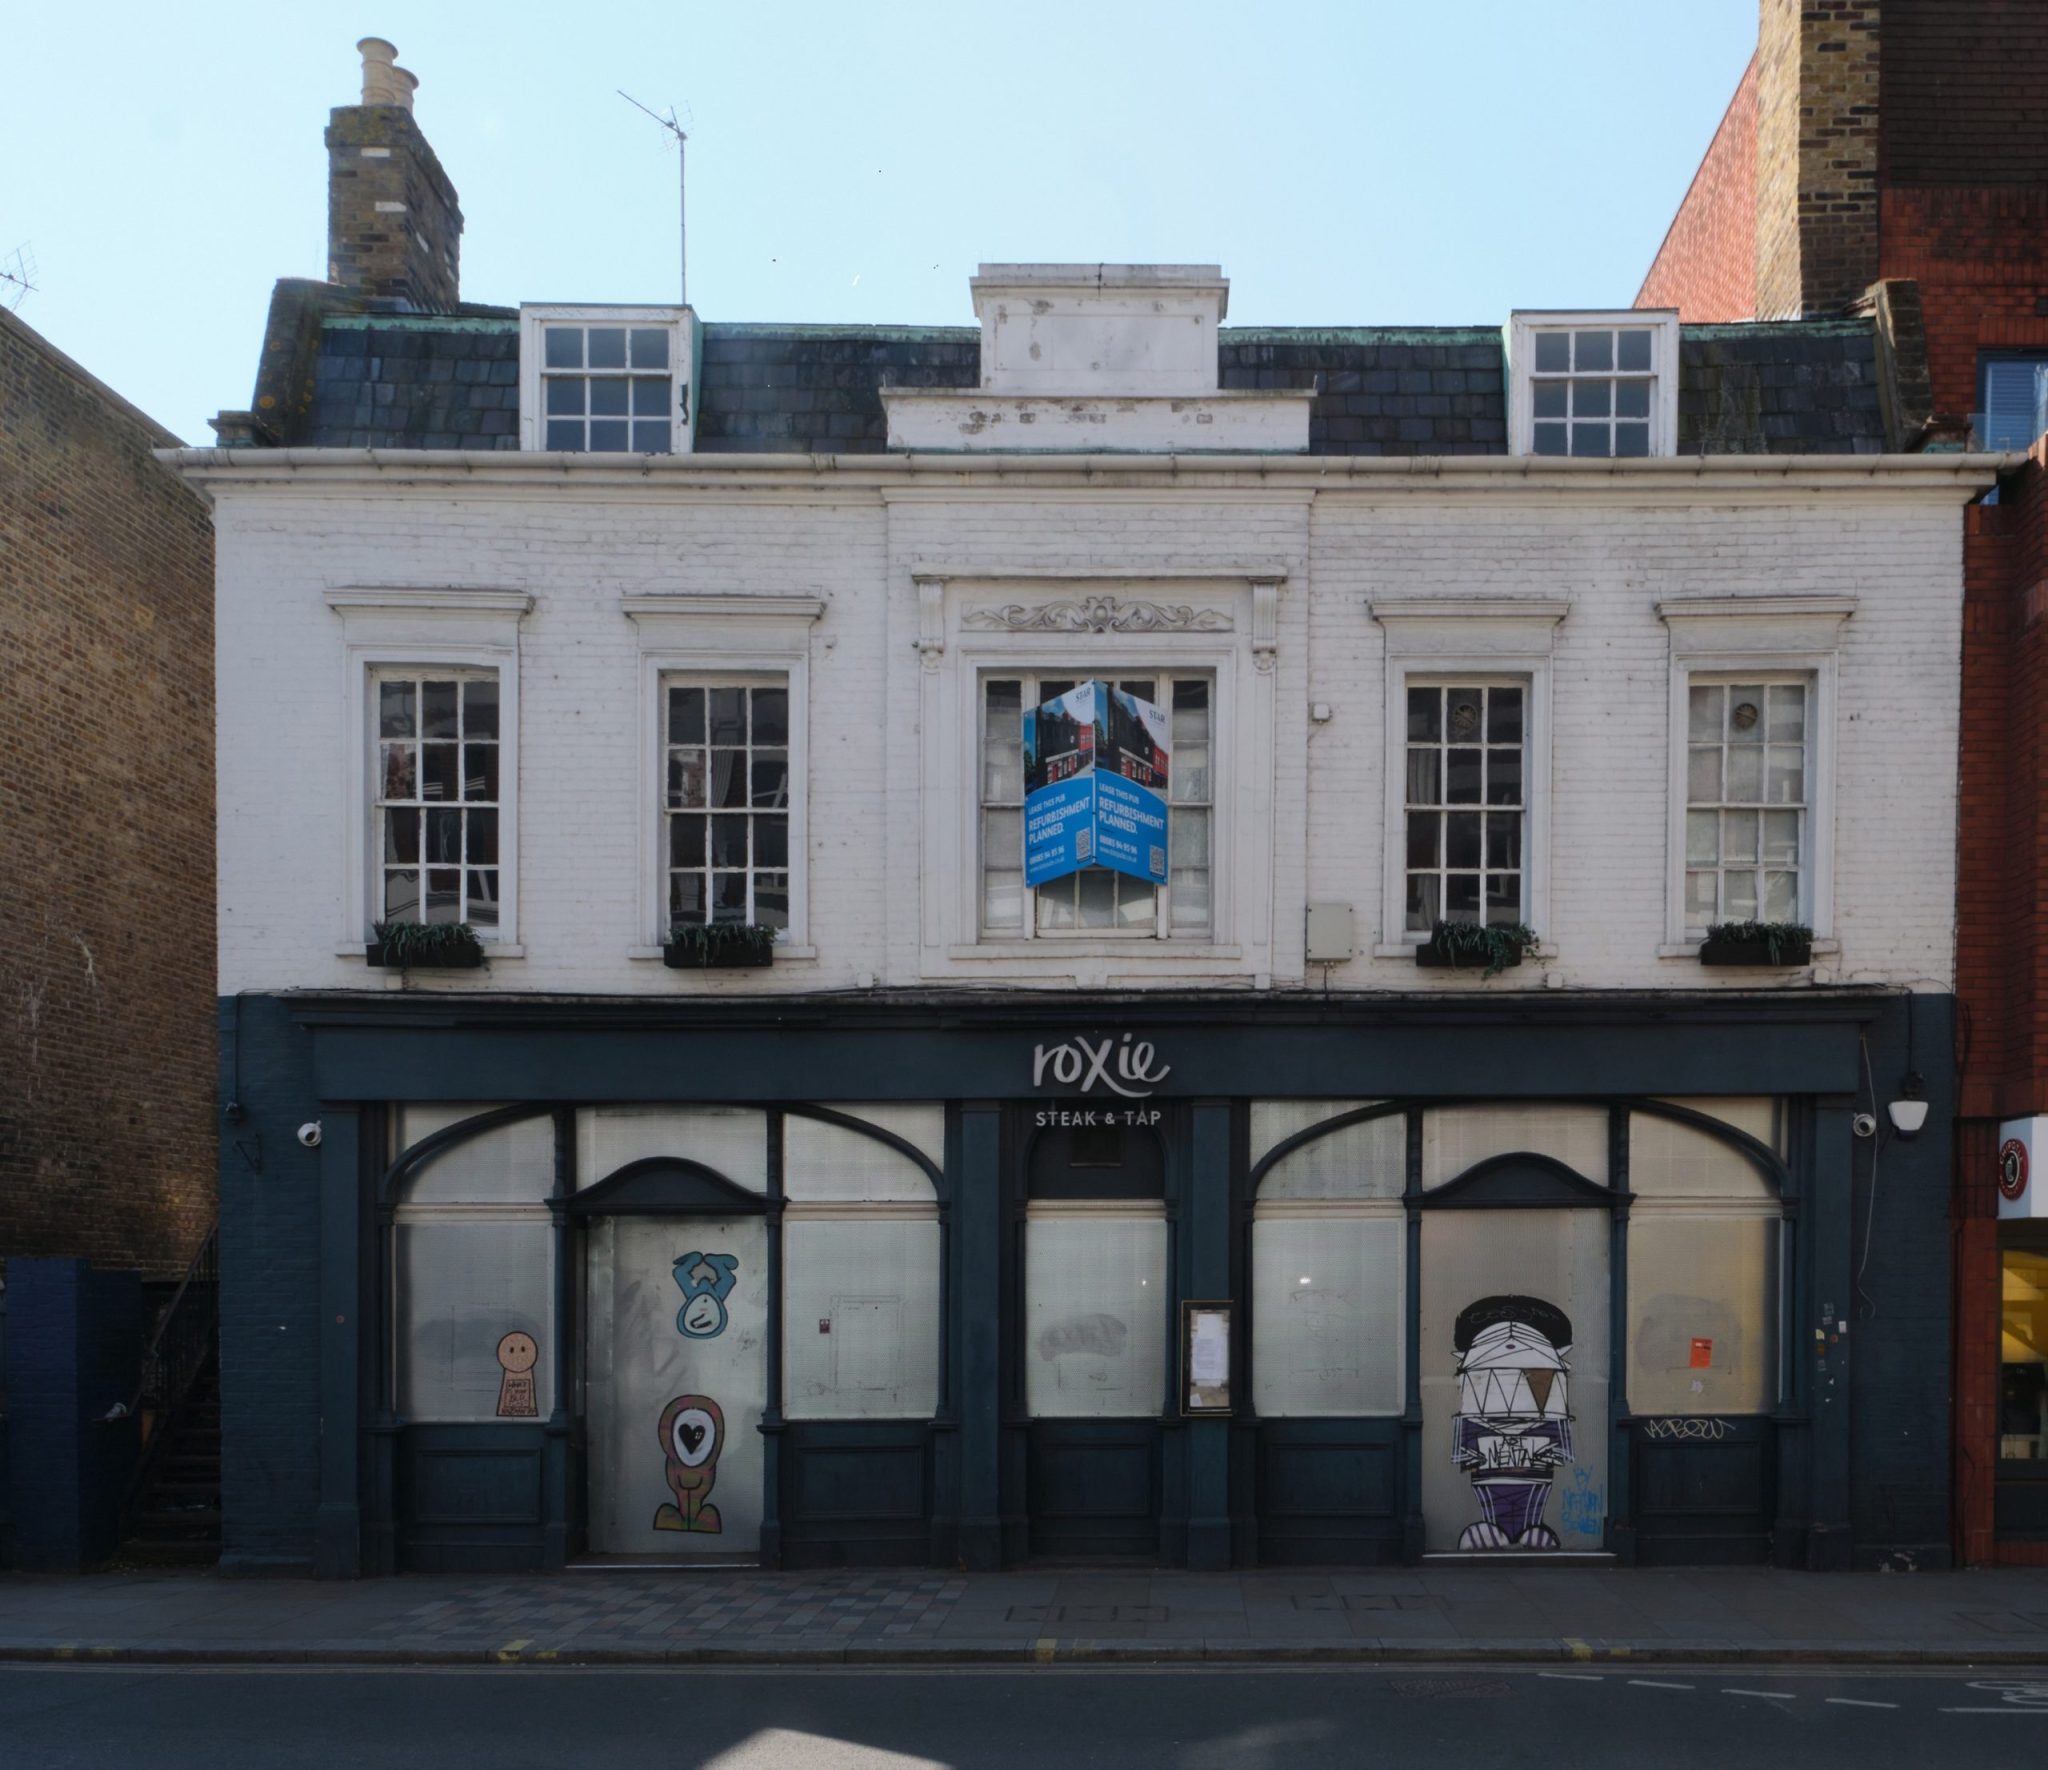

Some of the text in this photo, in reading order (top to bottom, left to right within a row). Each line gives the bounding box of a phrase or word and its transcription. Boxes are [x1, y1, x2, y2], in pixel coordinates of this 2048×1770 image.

[1149, 709, 1165, 722] STAR
[1099, 783, 1115, 796] LEASE
[1116, 788, 1128, 800] THIS
[1044, 798, 1055, 808] THIS
[1029, 796, 1090, 832] REFURBISHMENT
[1099, 796, 1164, 830] REFURBISHMENT
[1036, 1111, 1161, 1127] STEAK & TAP
